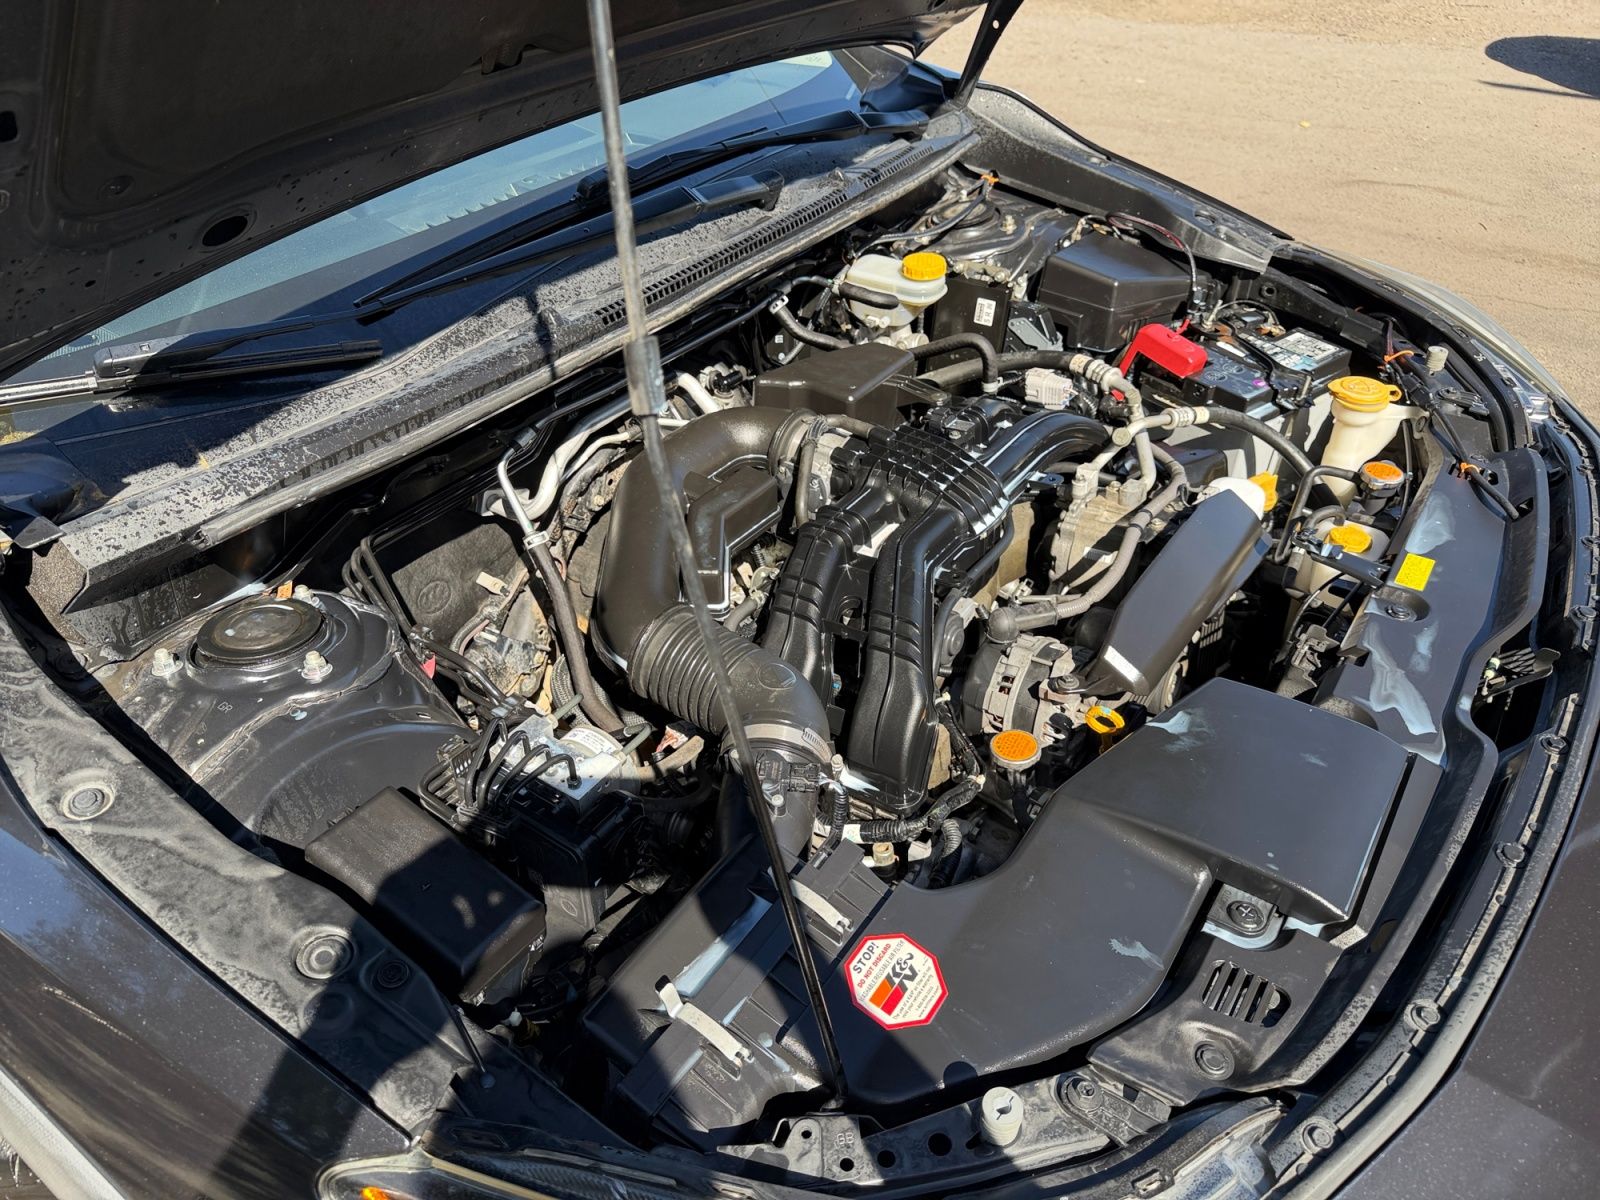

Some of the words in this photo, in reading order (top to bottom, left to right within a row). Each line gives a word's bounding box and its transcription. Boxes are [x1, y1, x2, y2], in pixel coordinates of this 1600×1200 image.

[852, 942, 879, 974] STOP!
[892, 939, 904, 954] FILTER
[857, 979, 866, 988] DO
[864, 966, 874, 979] NOT
[872, 943, 891, 967] DISCARD
[885, 952, 919, 993] K&N
